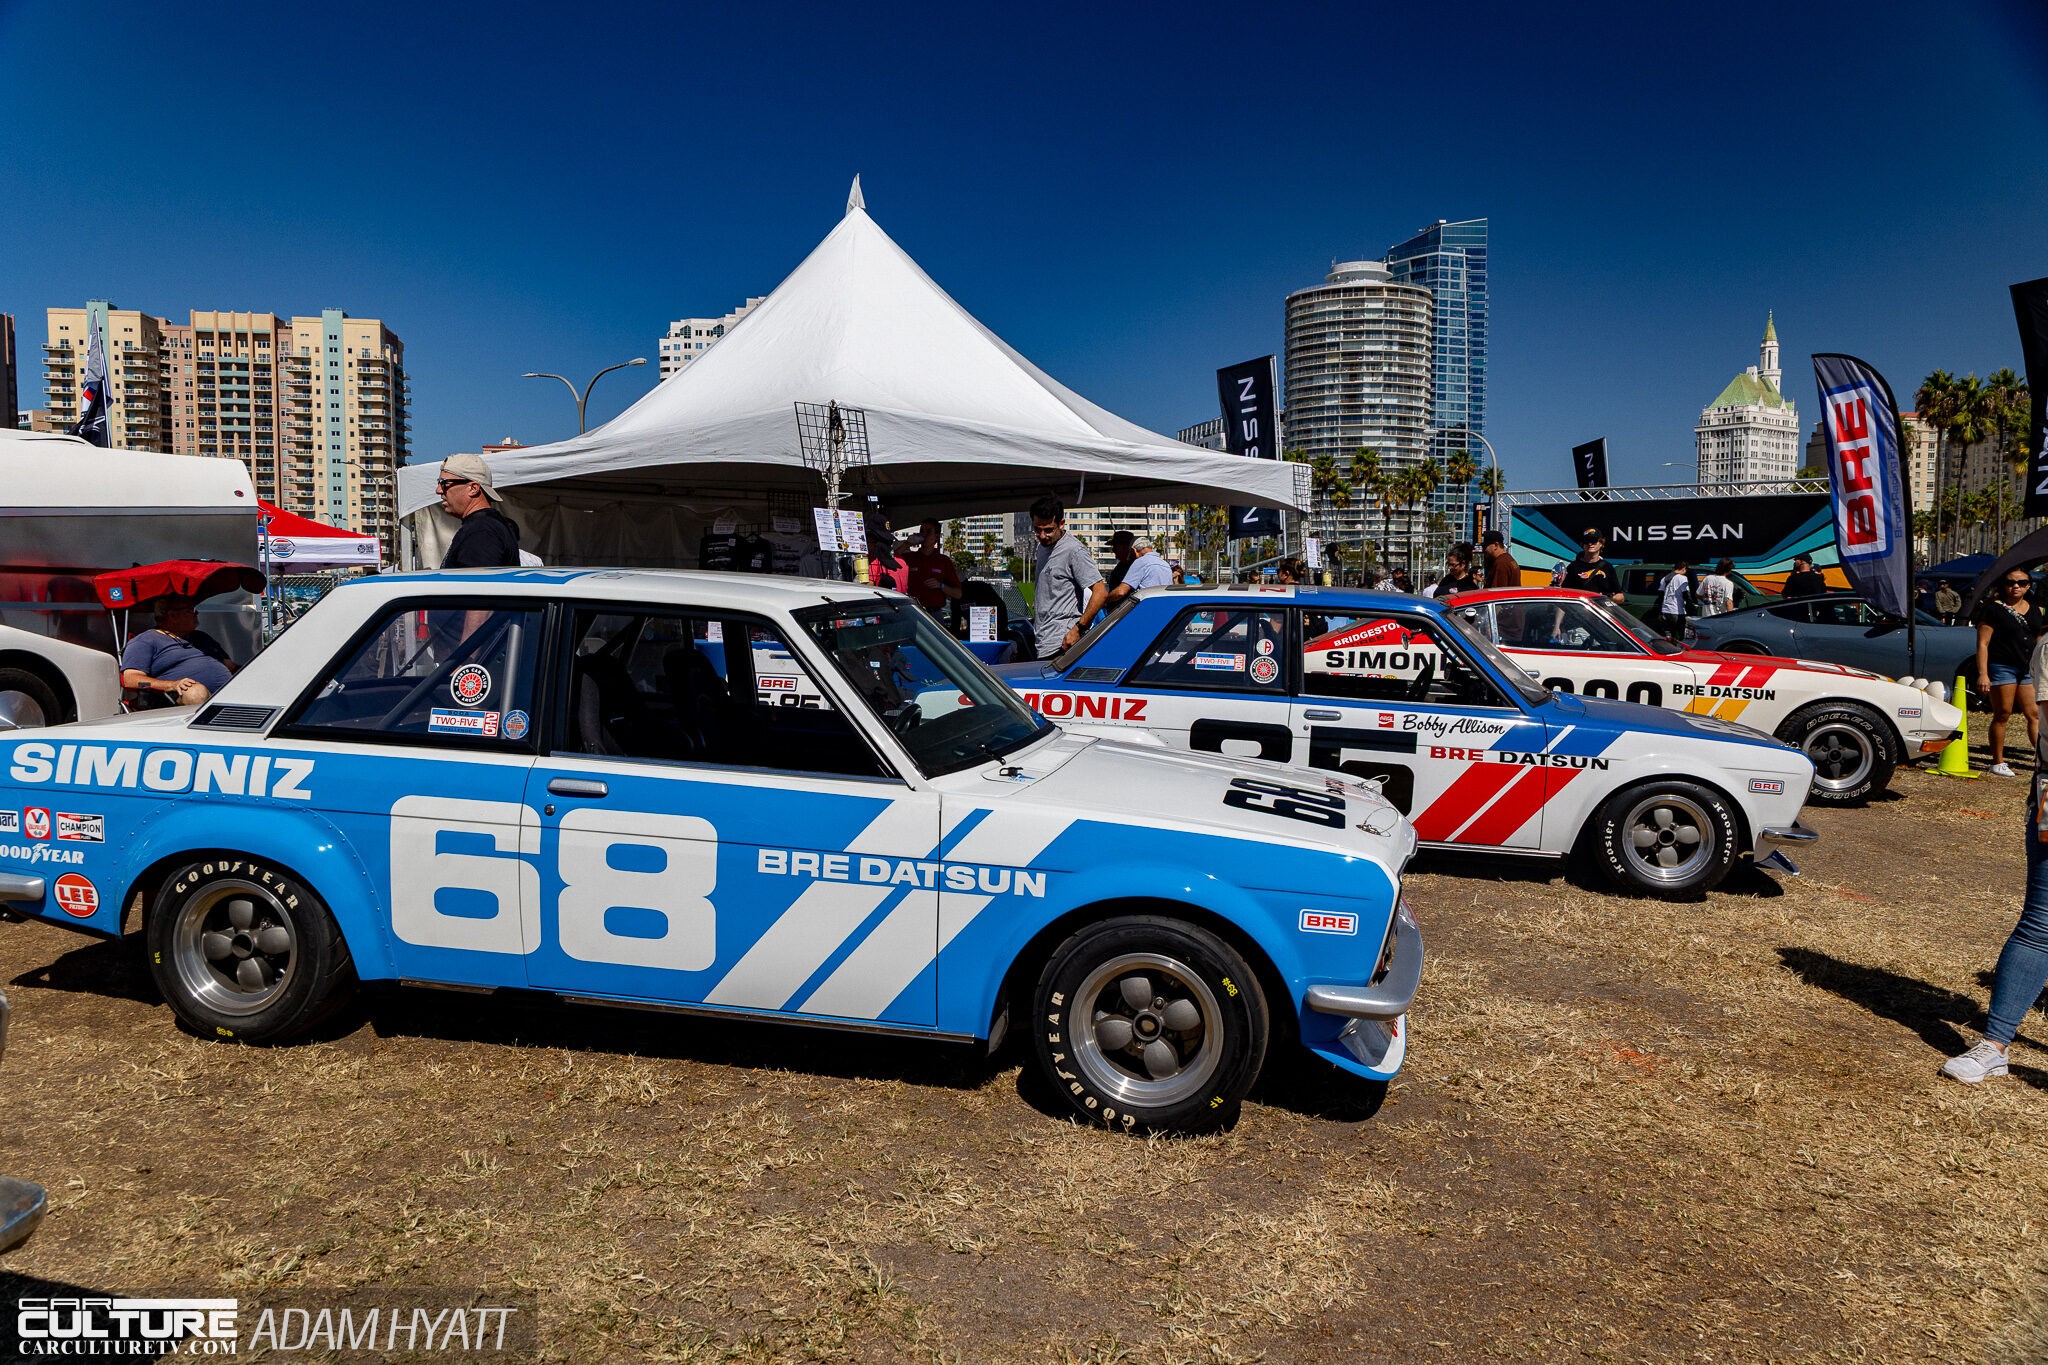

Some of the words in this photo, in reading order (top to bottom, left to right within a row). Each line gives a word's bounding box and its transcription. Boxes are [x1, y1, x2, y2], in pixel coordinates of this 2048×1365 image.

[1237, 376, 1259, 524] NISSN
[1835, 398, 1877, 546] BRE
[1612, 523, 1744, 542] NISSAN
[1333, 622, 1400, 647] BRIDGESTO
[1350, 635, 1385, 646] TIRES
[1325, 651, 1446, 672] SIMONI
[455, 668, 470, 686] SPORTS
[471, 667, 482, 675] CAR
[760, 679, 794, 689] BRE
[461, 692, 484, 703] AMERICA
[1672, 684, 1705, 696] BRE
[1710, 687, 1776, 701] DATSUN
[435, 716, 478, 727] TWO-FIVE
[1402, 714, 1447, 738] Bobby
[1448, 717, 1505, 734] Allison
[1430, 746, 1484, 762] BRE
[1499, 751, 1609, 771] DATSUN
[9, 742, 316, 800] SIMONIZ
[1753, 782, 1780, 791] BRE
[1811, 778, 1872, 799] BRIDGE
[60, 822, 101, 833] CHAMPION
[0, 843, 84, 864] OODYEAR
[389, 795, 719, 973] 68
[757, 848, 850, 882] BRE
[858, 855, 1048, 899] DATSUN
[58, 885, 94, 904] LEE
[175, 861, 299, 910] GOODYEAR
[1306, 915, 1351, 930] BRE
[1221, 976, 1239, 998] #68
